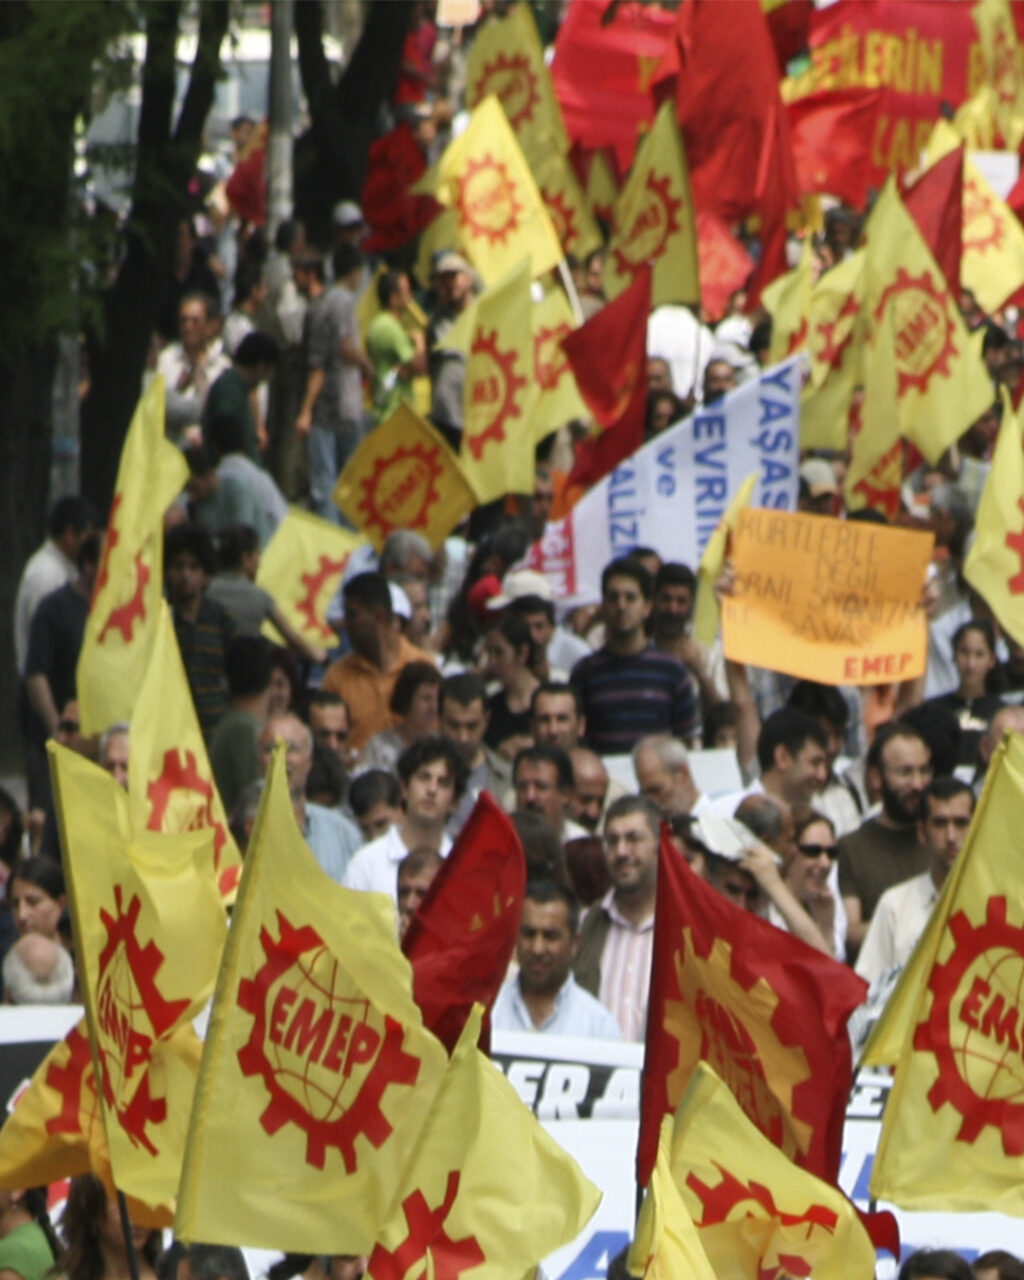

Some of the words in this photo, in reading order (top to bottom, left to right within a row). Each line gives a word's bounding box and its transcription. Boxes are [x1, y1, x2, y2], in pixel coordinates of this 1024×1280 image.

[750, 367, 793, 509] YAŞAS
[844, 653, 912, 679] EMEP
[269, 984, 382, 1079] EMEP
